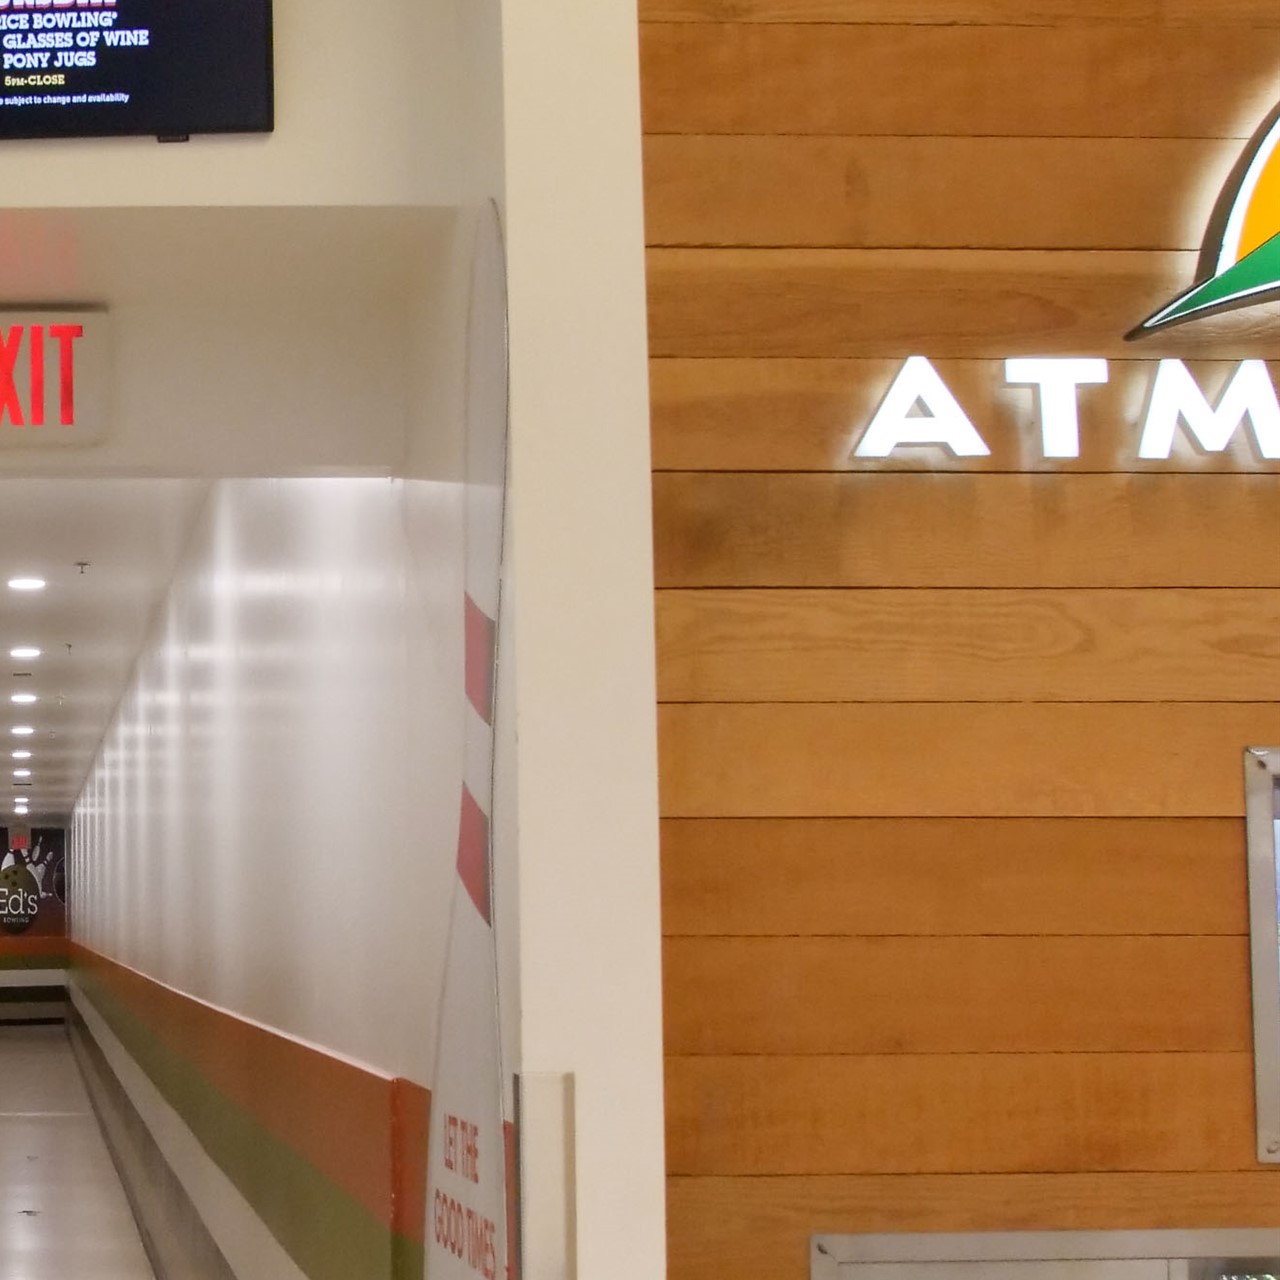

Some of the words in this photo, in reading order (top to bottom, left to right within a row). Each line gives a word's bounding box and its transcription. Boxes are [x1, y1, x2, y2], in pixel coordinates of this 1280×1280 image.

[2, 31, 73, 49] GLASSES
[76, 30, 100, 47] OF
[103, 29, 149, 46] WINE
[3, 52, 51, 69] PONY
[54, 51, 96, 67] JUGS
[4, 96, 32, 107] subject
[33, 96, 42, 105] to
[43, 95, 70, 106] change
[72, 94, 86, 103] and
[87, 92, 129, 104] availability
[444, 1113, 458, 1172] LET
[460, 1119, 479, 1184] THE
[434, 1188, 464, 1258] GOOD
